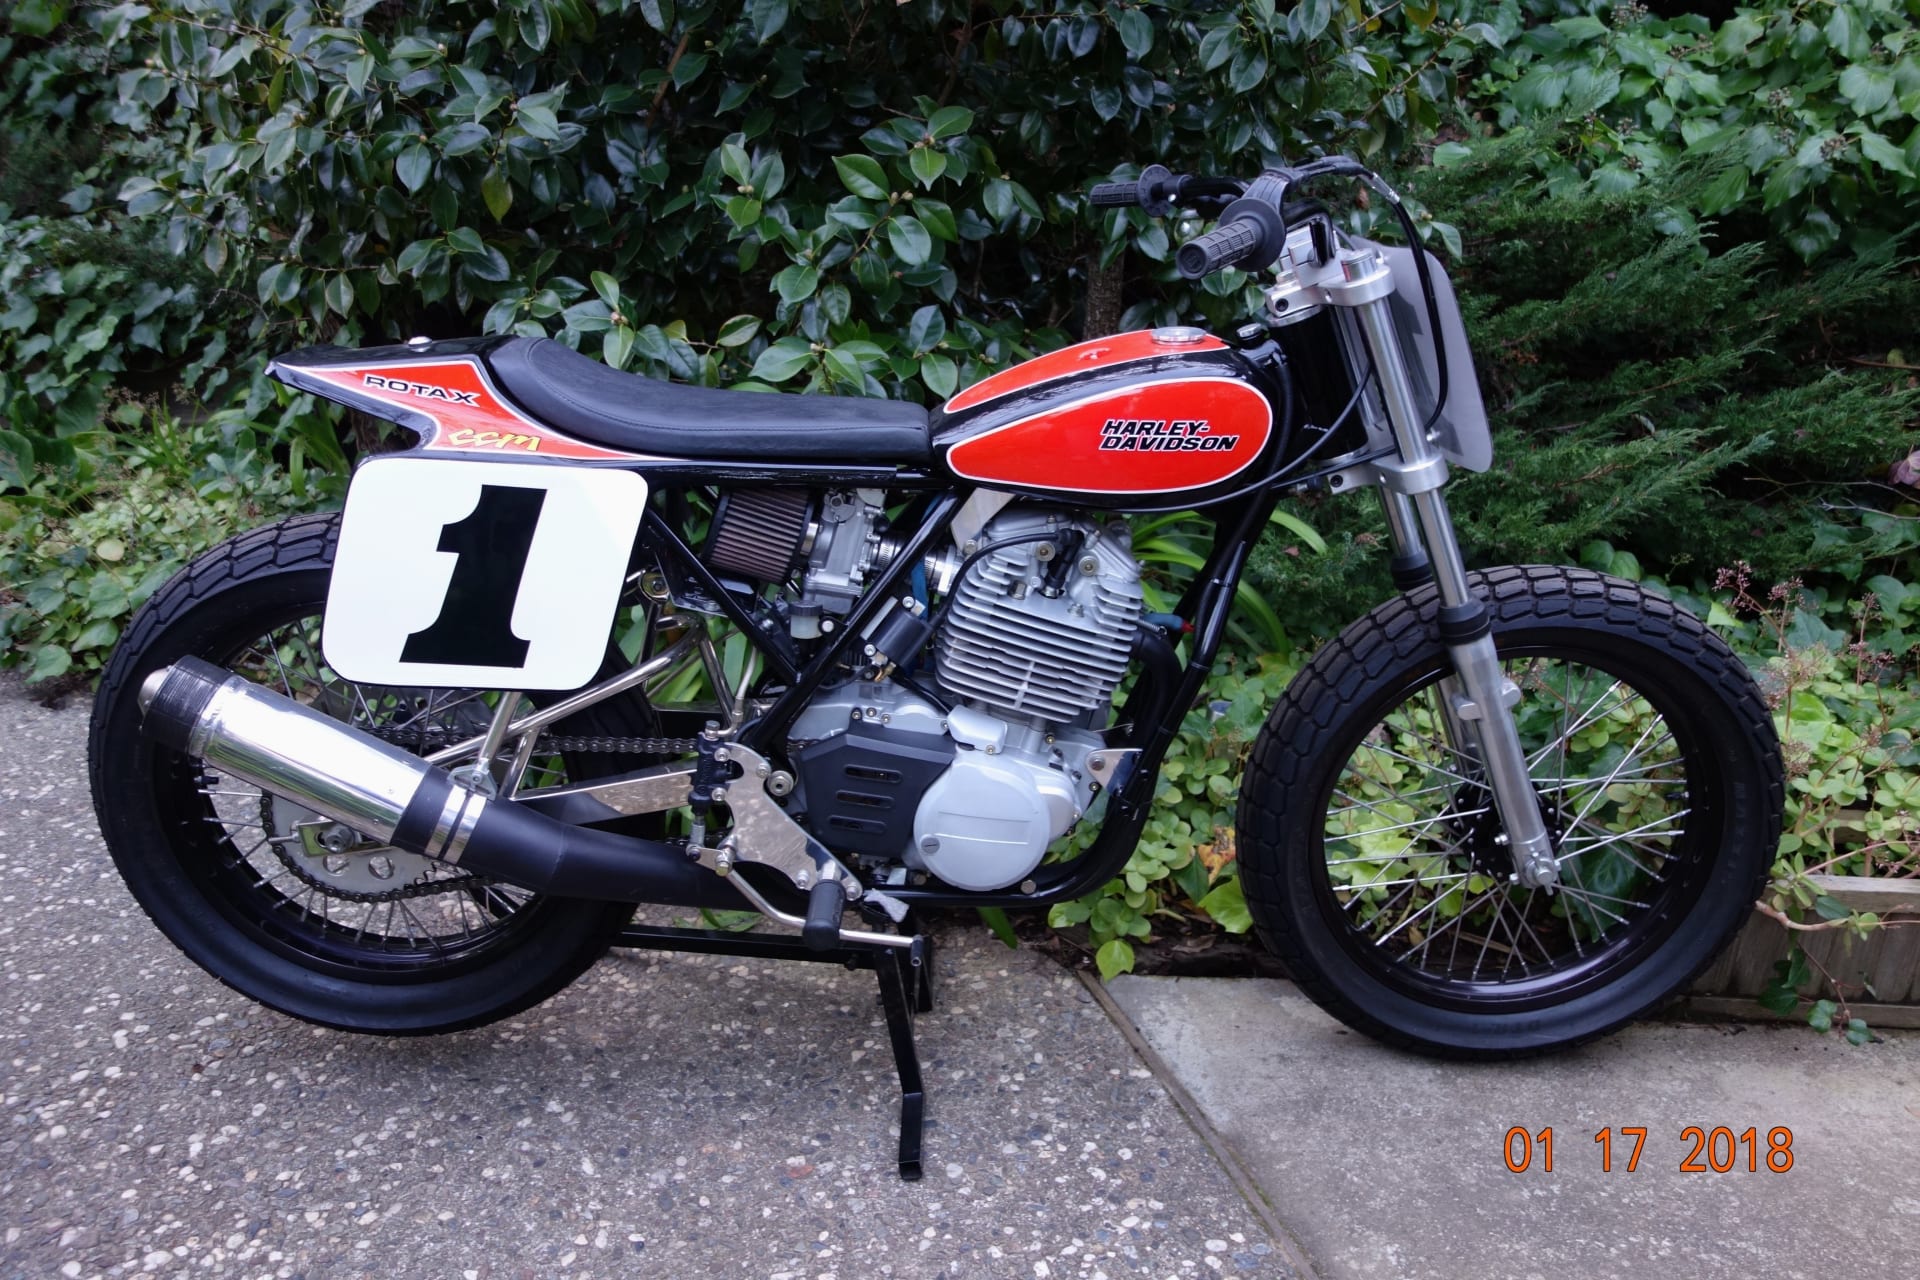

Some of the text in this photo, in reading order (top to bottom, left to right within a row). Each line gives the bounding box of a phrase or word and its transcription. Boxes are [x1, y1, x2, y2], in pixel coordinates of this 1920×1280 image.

[364, 375, 480, 407] ROTAX
[1101, 419, 1211, 437] HARLEY-
[1099, 435, 1240, 452] DAVIDSON
[399, 484, 548, 669] 1
